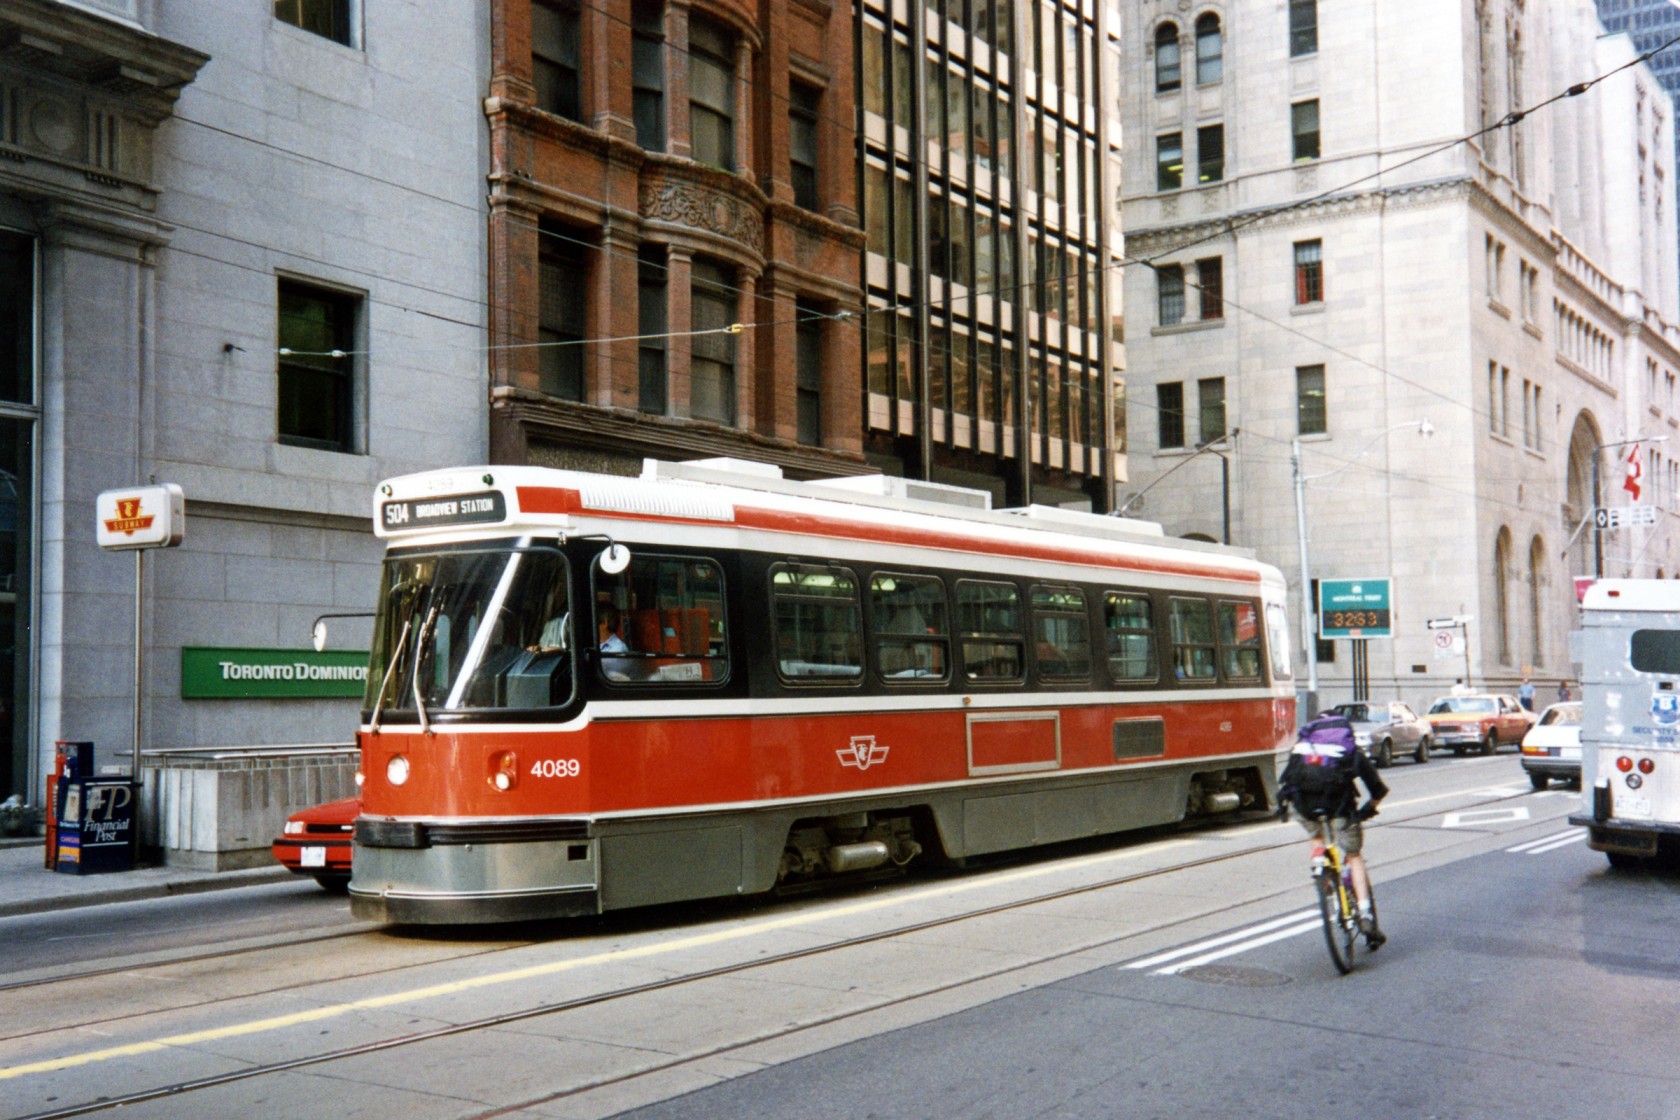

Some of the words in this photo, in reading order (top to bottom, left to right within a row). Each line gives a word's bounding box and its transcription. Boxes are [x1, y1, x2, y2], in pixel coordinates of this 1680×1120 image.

[386, 503, 409, 524] 504
[416, 502, 458, 518] BROADVIEW
[460, 498, 494, 514] STATION
[113, 520, 145, 530] SUBWAY
[219, 661, 294, 680] TORONTO
[530, 759, 580, 778] 4089
[84, 818, 130, 832] Financial
[95, 829, 117, 841] Post
